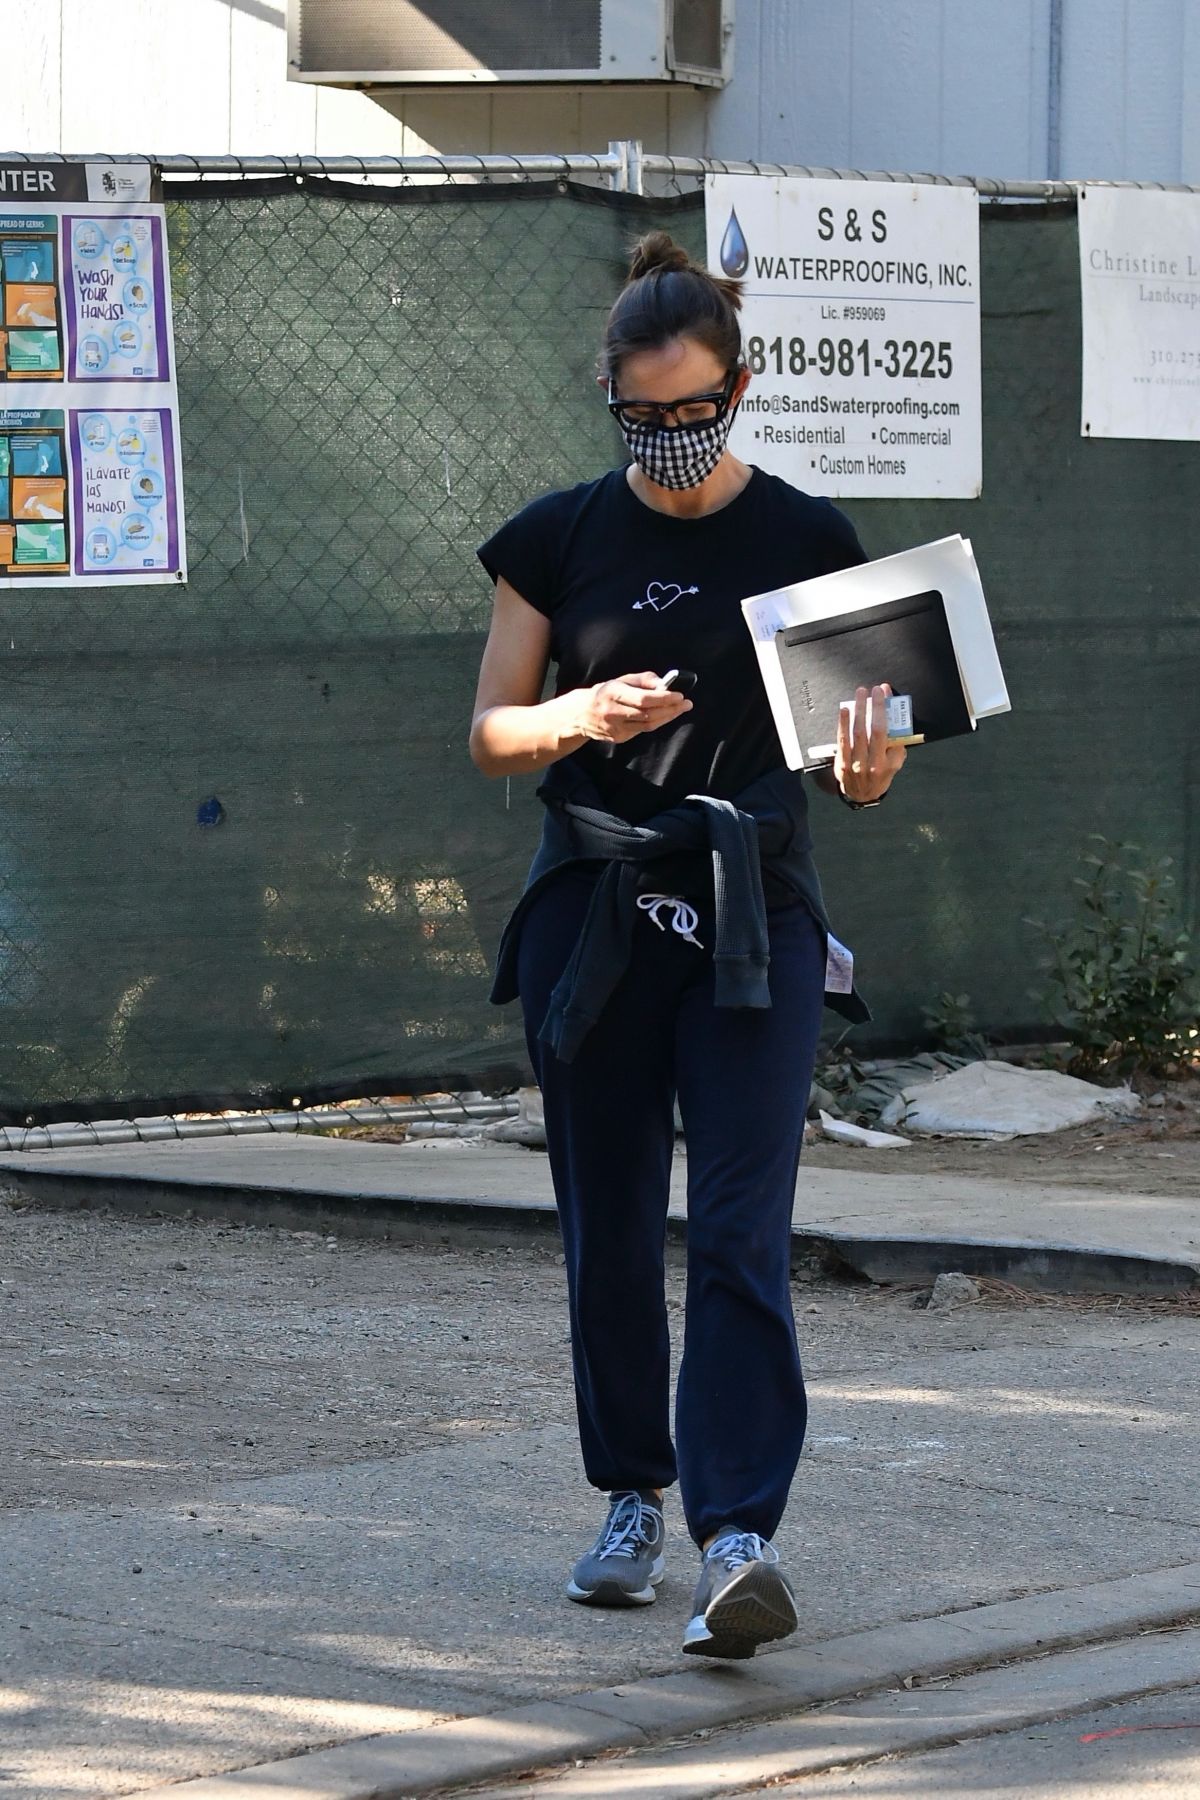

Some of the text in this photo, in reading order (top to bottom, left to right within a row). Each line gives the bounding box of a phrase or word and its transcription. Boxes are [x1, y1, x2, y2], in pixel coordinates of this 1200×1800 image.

[817, 207, 887, 243] S & S
[754, 256, 972, 288] WATERPROOFING, INC.
[1090, 248, 1177, 275] Christine
[1139, 284, 1200, 310] Landscap
[821, 306, 886, 321] Lic. #959069
[749, 336, 953, 379] 818-981-3225
[741, 395, 960, 419] info@SandSwaterproofing.com
[763, 426, 845, 444] Residential
[879, 427, 951, 446] Commercial
[819, 456, 906, 475] Custom Homes
